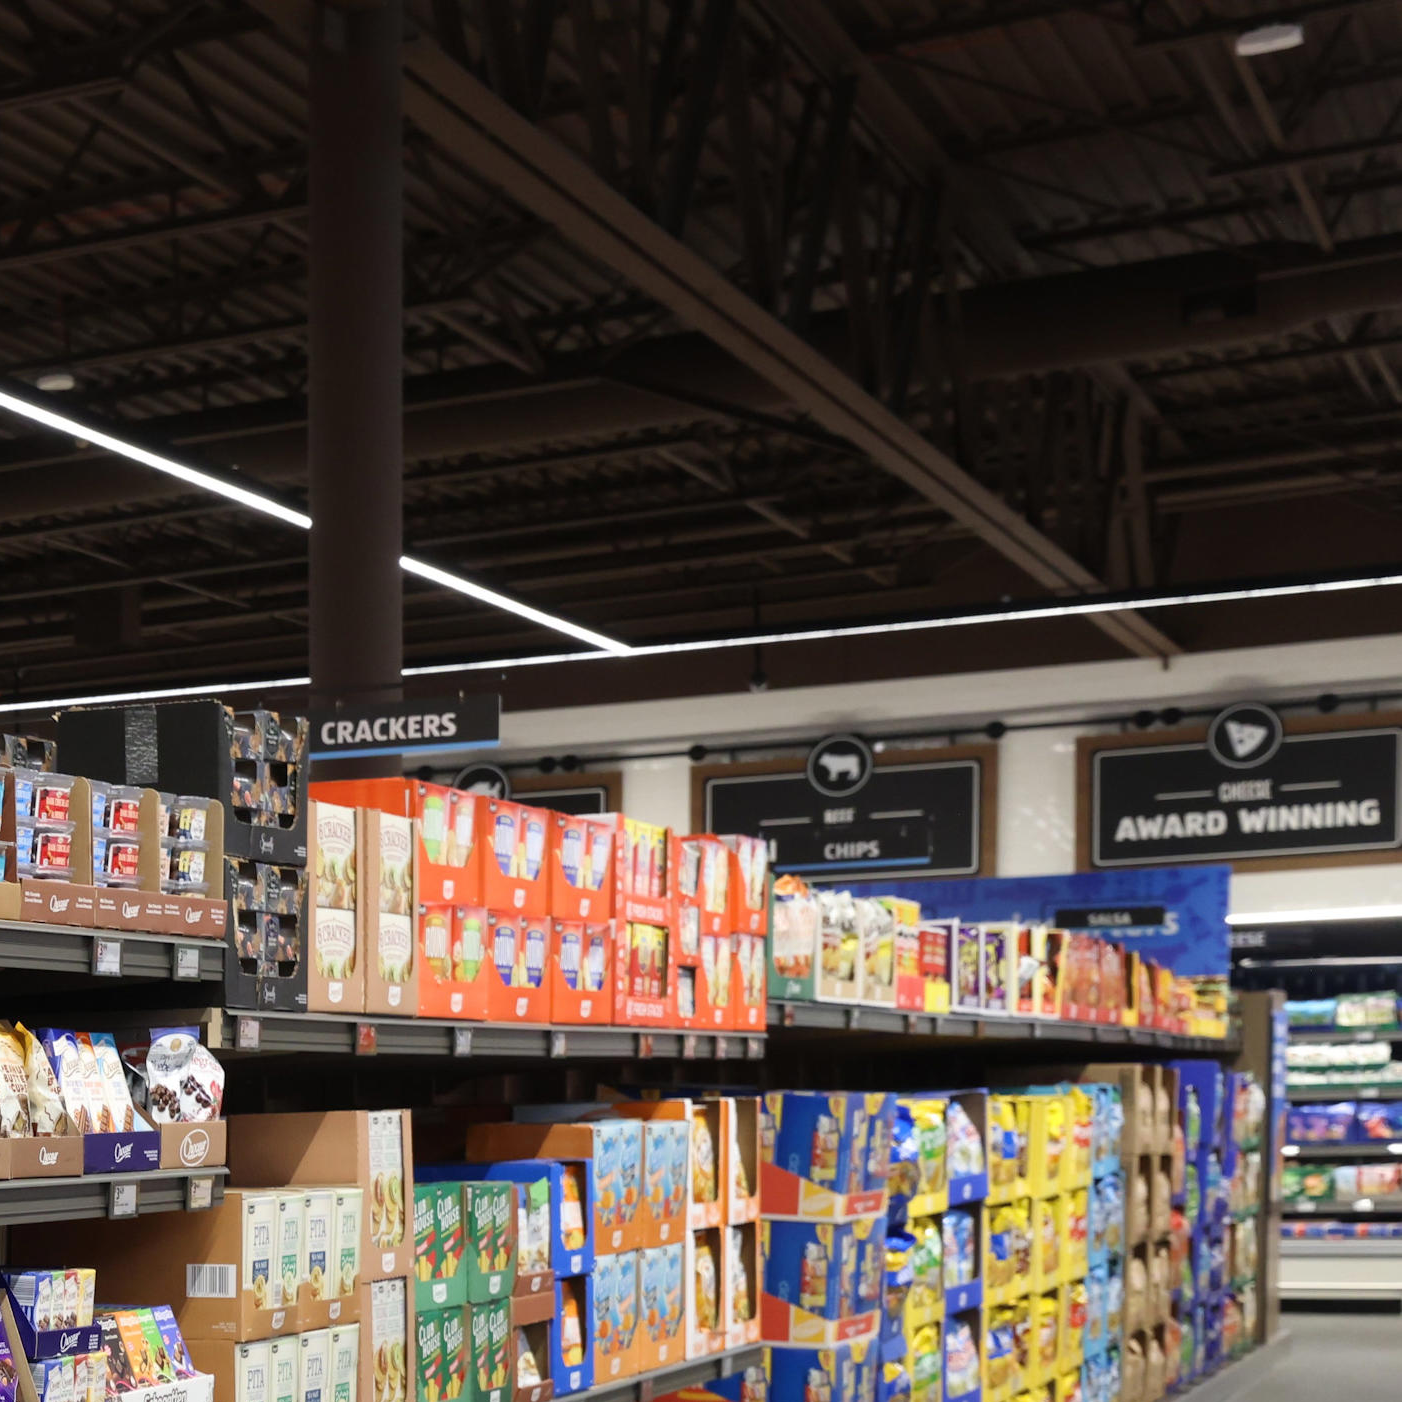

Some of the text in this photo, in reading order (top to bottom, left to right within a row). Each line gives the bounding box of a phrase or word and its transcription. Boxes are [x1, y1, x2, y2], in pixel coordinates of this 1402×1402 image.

[321, 712, 456, 745] CRACKERS
[1116, 800, 1381, 841] AWARD WINNING
[824, 840, 880, 859] CHIPS
[437, 1196, 453, 1220] CLUB
[475, 1192, 489, 1217] CLUB
[441, 1211, 461, 1230] HOUSE
[477, 1207, 493, 1227] HOUSE
[254, 1226, 270, 1247] PITA
[310, 1219, 327, 1240] PITA
[419, 1318, 435, 1345] CLUB
[444, 1317, 458, 1343] CLUB
[422, 1336, 441, 1358] HOUSE
[447, 1334, 463, 1354] HOUSE
[247, 1367, 265, 1389] PITA
[307, 1359, 323, 1379] PITA
